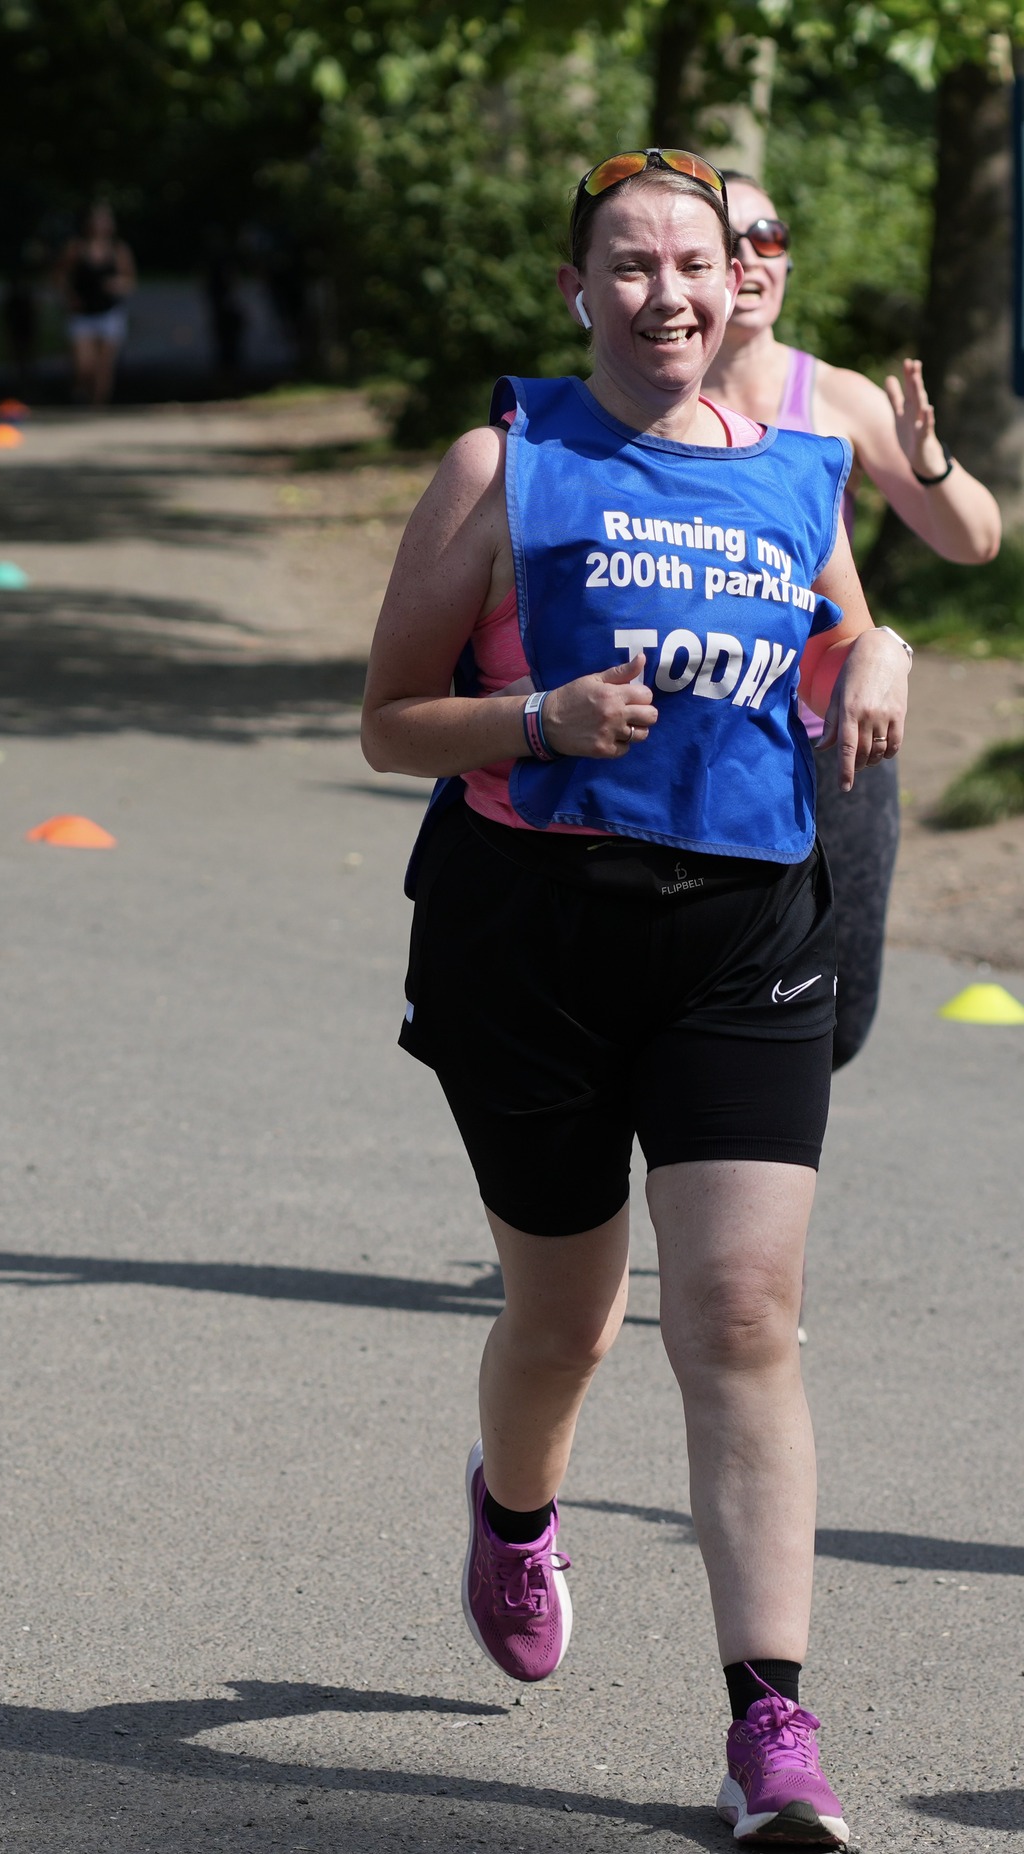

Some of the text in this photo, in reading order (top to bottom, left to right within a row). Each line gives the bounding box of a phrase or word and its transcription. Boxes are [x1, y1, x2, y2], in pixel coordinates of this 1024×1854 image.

[603, 511, 792, 582] Running my
[585, 551, 816, 613] 200th parkrun
[614, 628, 798, 710] TODAY
[661, 877, 705, 896] FLIPBELT
